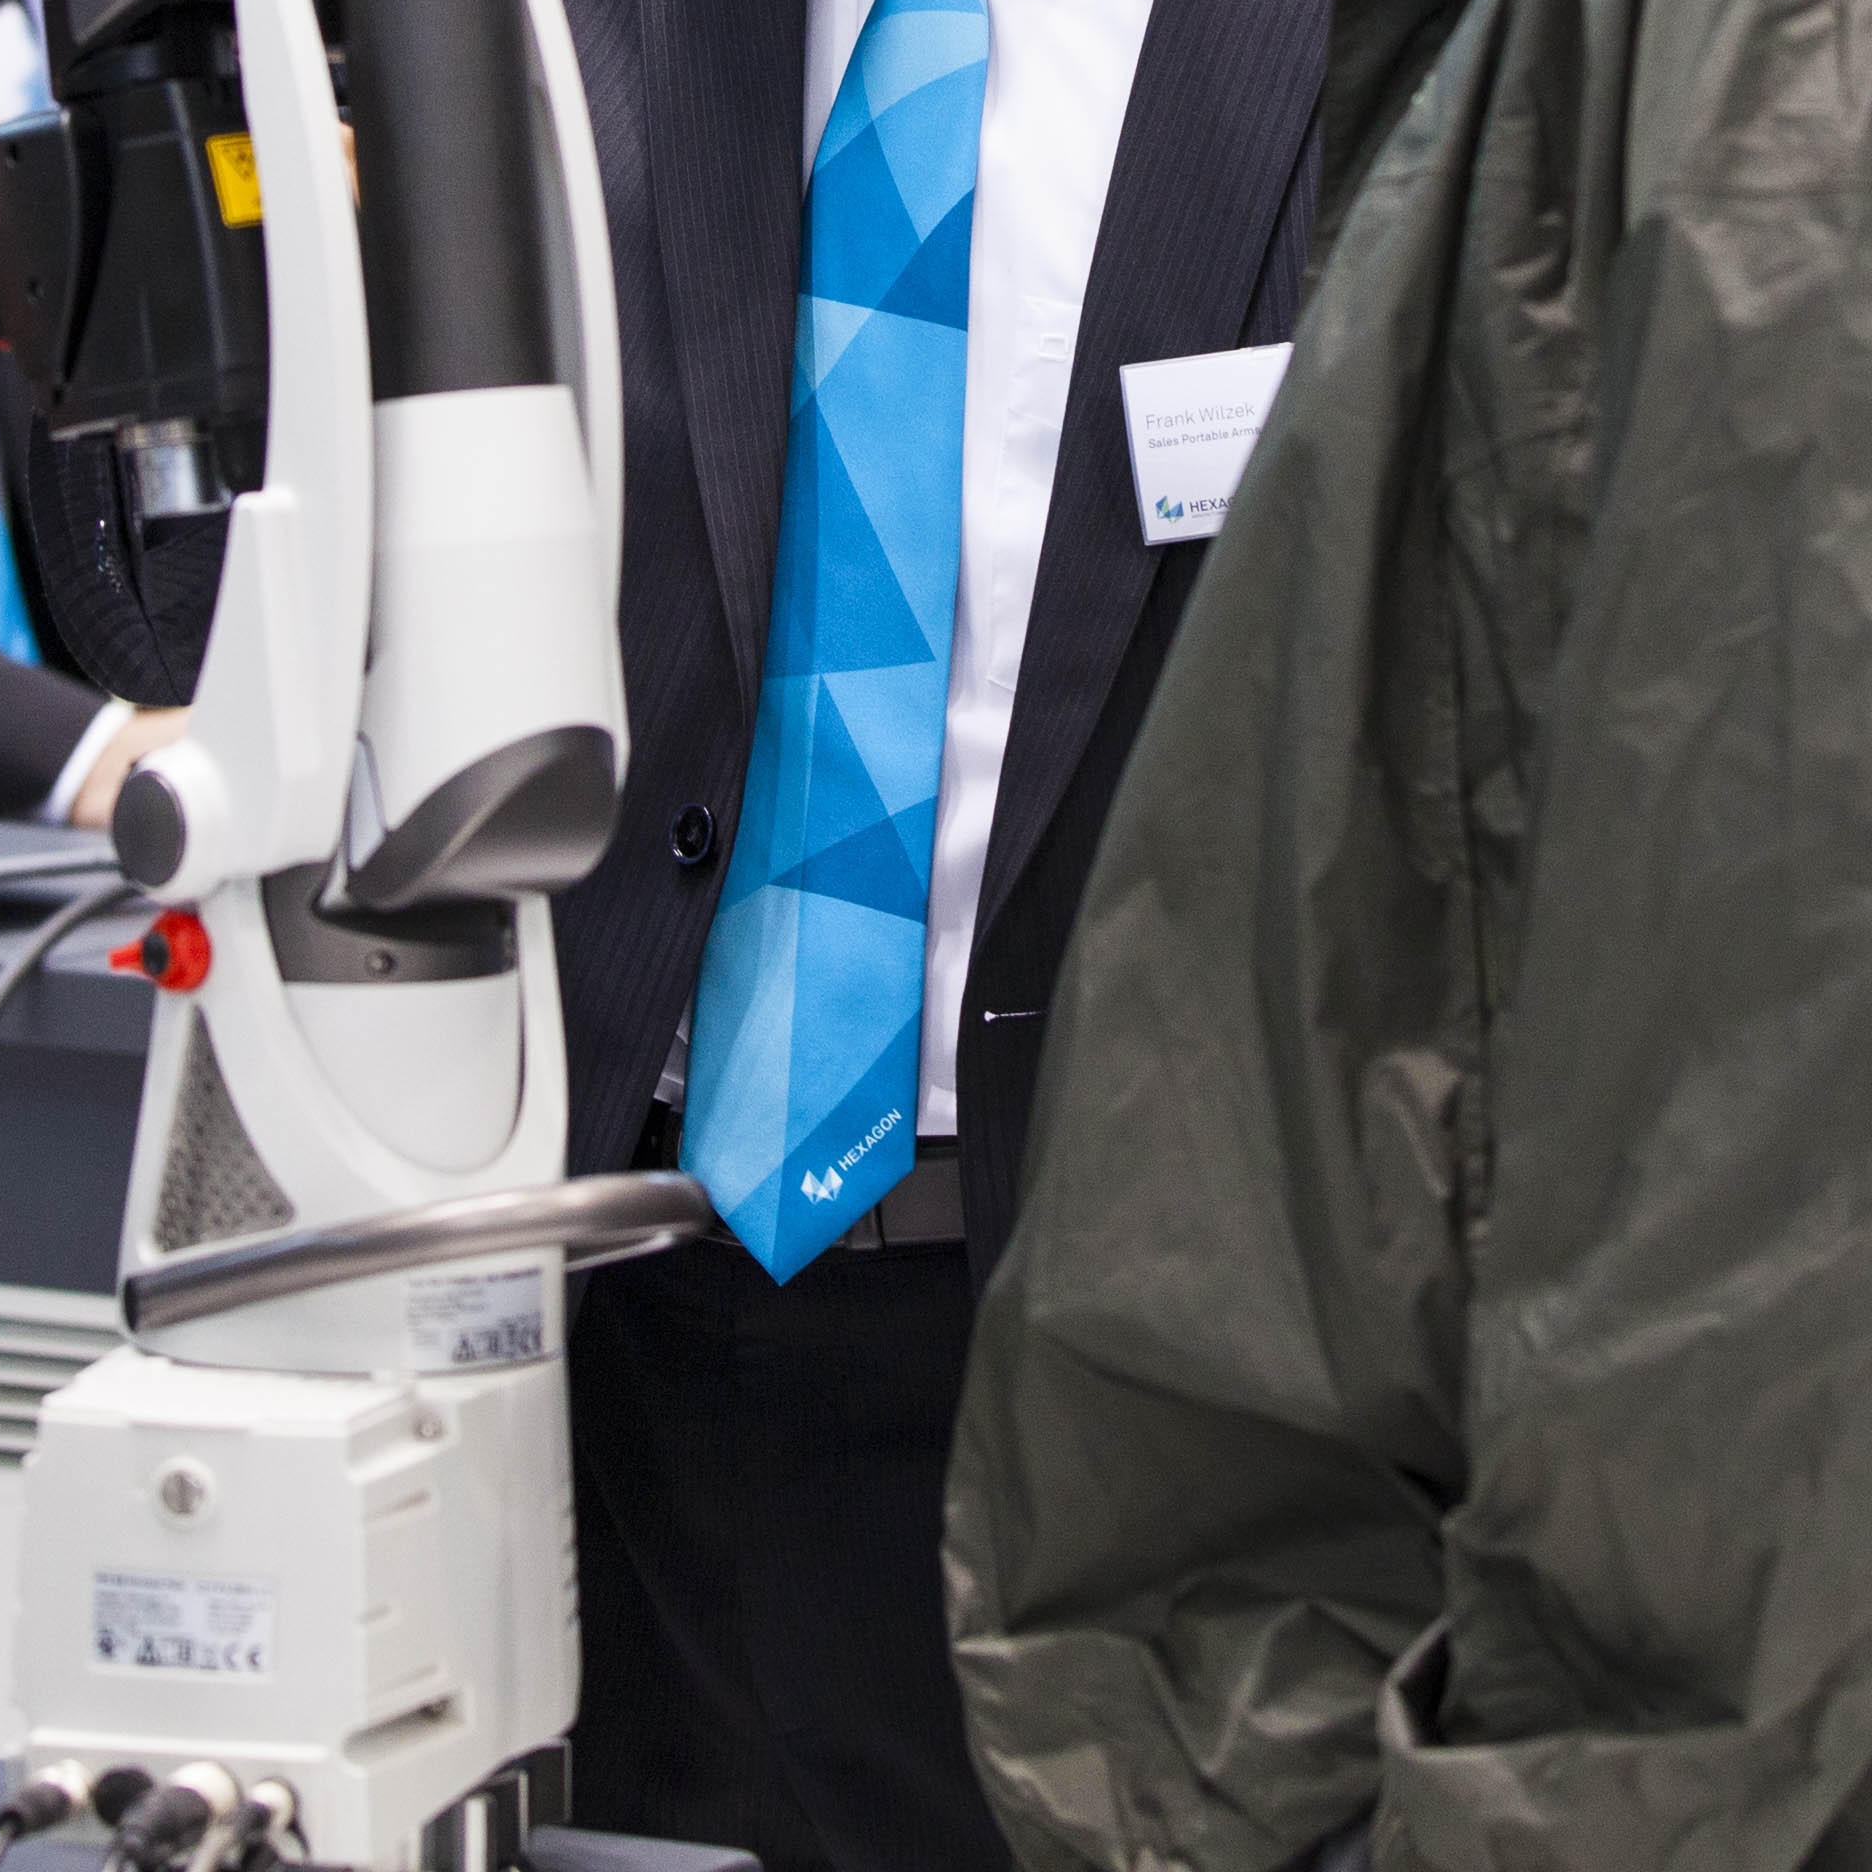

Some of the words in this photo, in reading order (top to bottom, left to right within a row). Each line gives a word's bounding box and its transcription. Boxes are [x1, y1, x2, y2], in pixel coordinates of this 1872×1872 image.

[1145, 409, 1196, 430] Frank
[1198, 401, 1256, 423] Wilzek
[1148, 437, 1180, 450] Sales
[1182, 429, 1229, 445] Portable
[836, 1108, 903, 1172] HEXAGON
